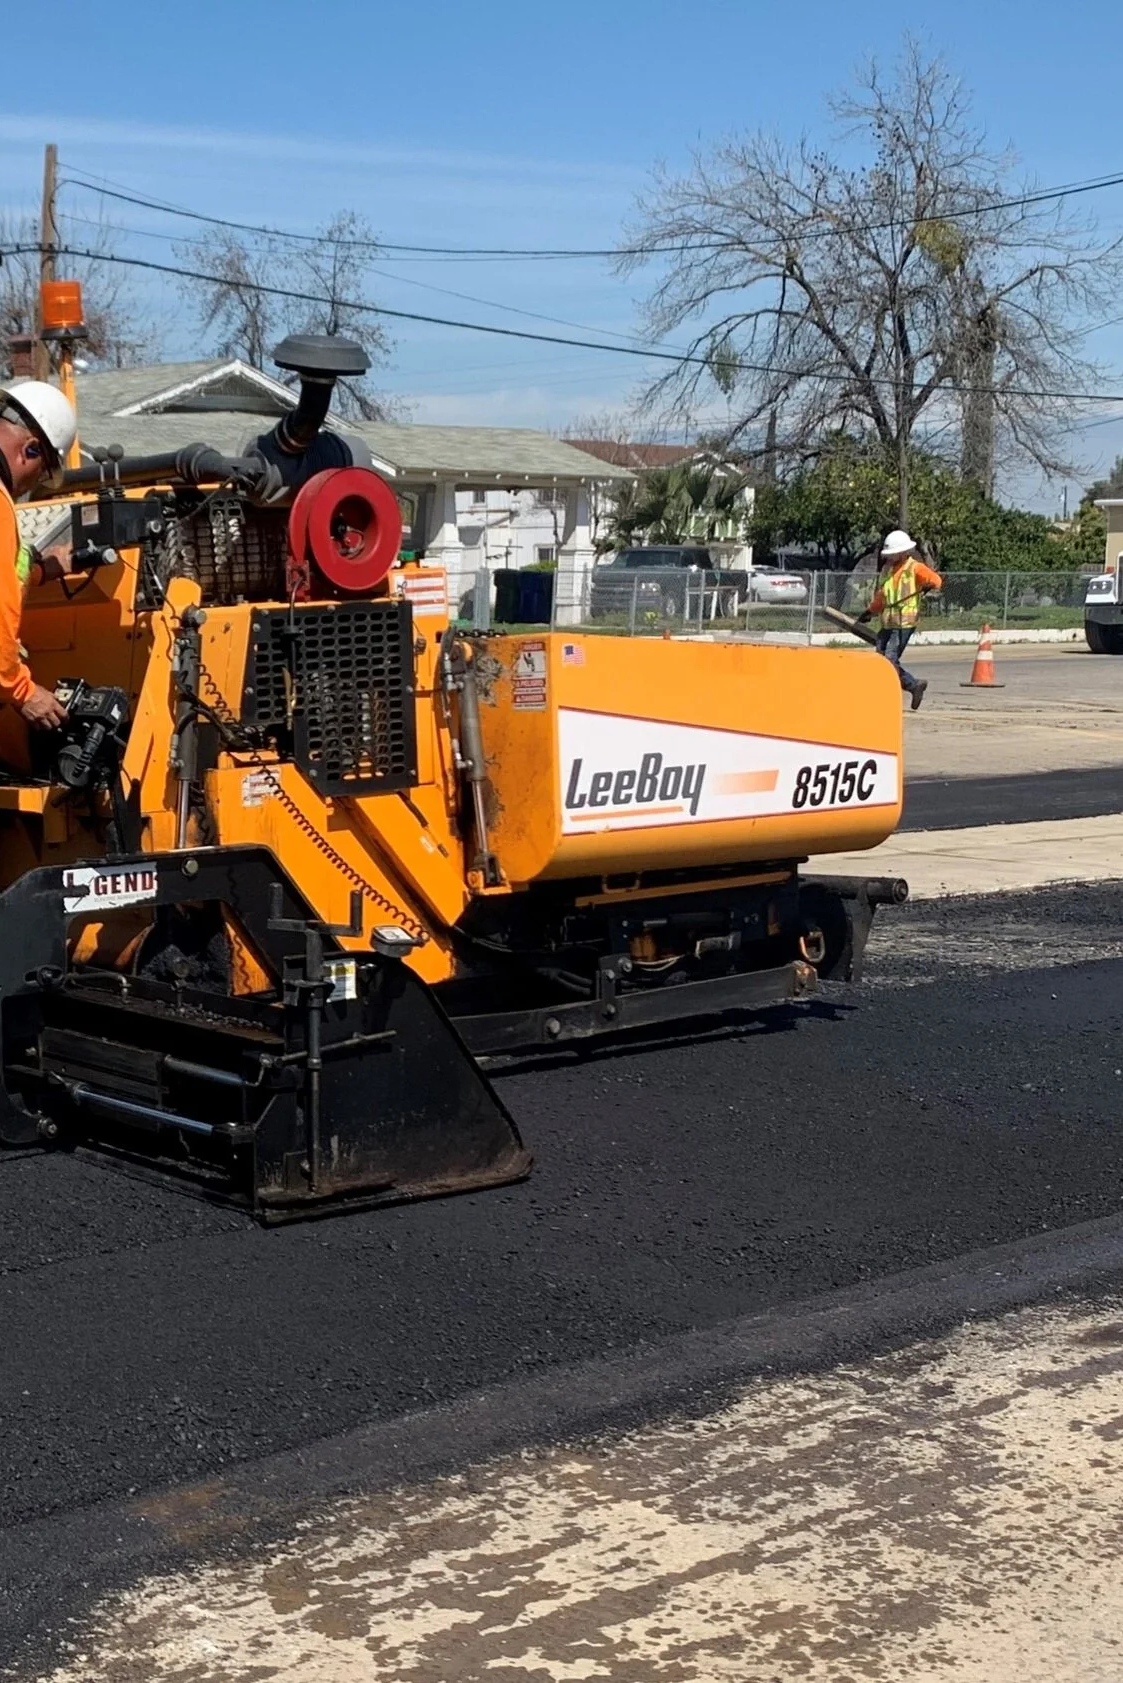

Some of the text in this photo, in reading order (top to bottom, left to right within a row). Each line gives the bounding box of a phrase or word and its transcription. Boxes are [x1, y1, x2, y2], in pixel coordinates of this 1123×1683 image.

[565, 752, 707, 816] LeeBoy
[792, 759, 877, 808] 8515C
[66, 871, 154, 896] LGEND
